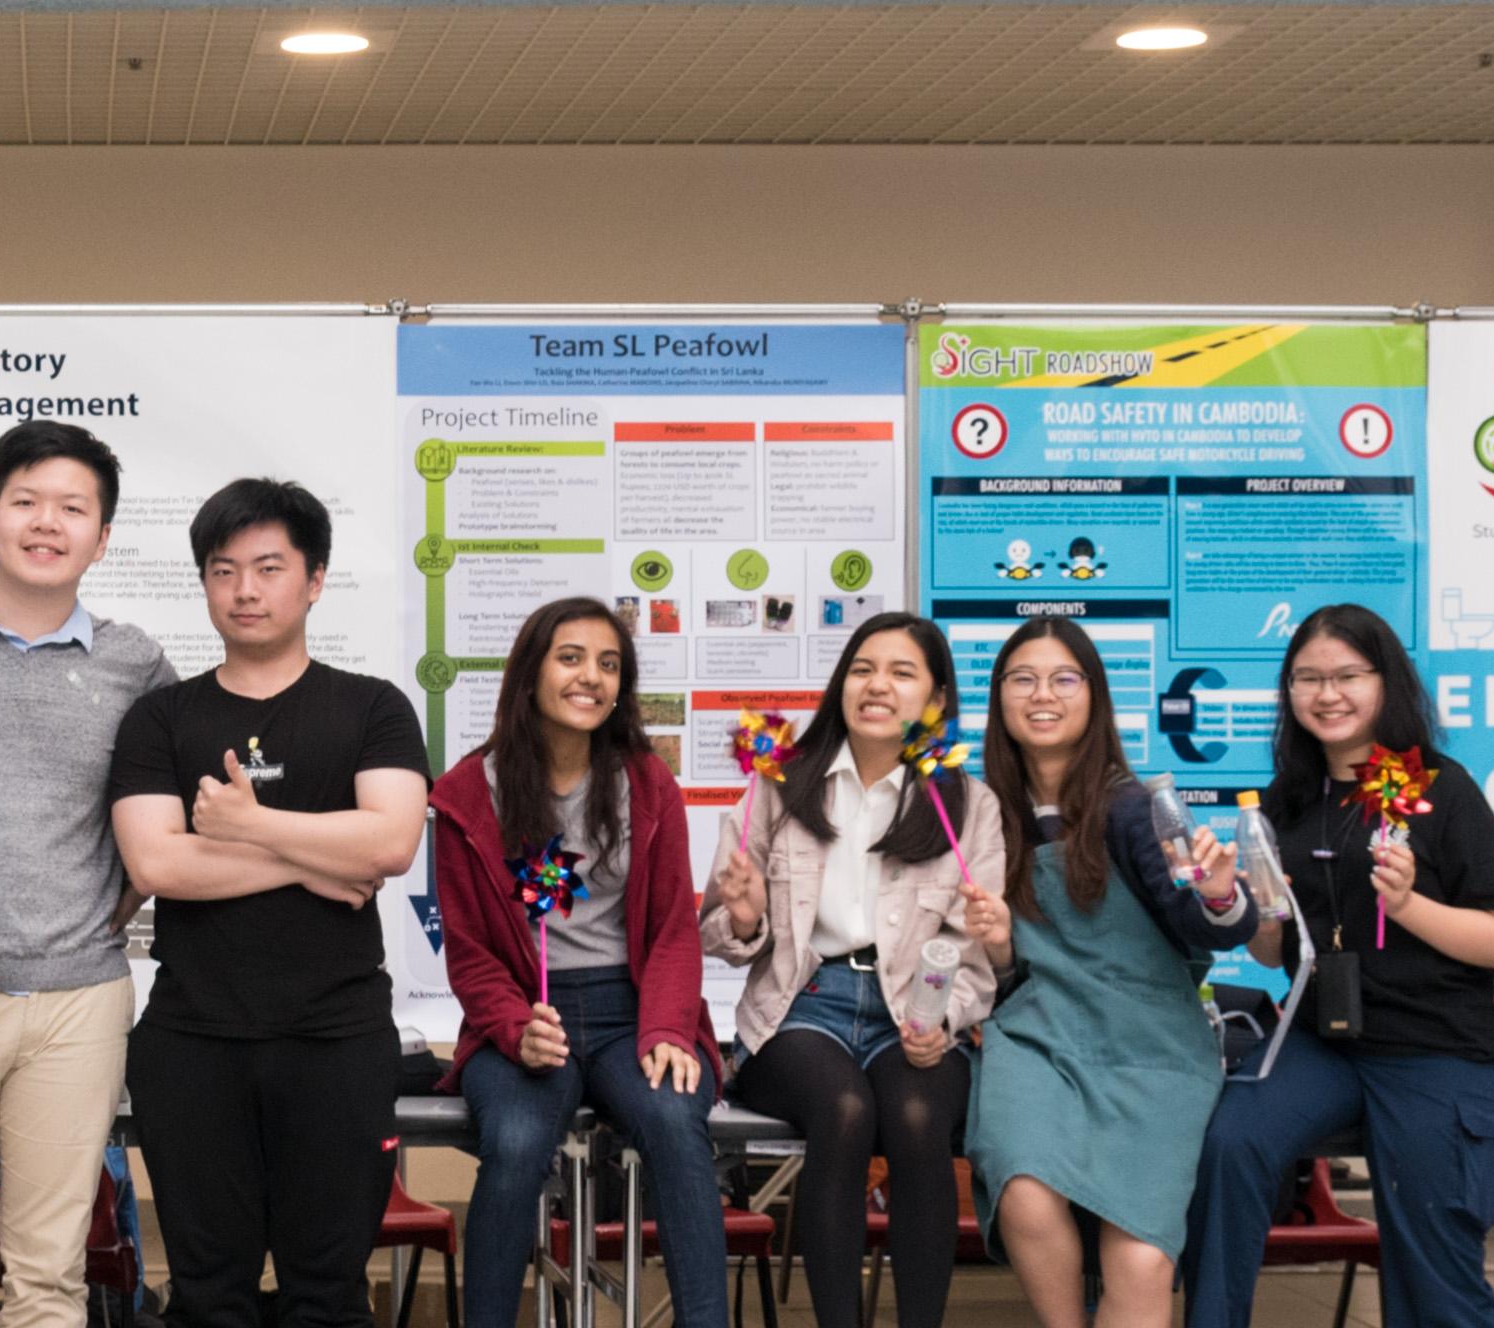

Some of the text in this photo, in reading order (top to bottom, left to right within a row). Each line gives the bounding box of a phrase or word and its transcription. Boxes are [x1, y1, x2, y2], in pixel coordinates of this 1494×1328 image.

[530, 333, 769, 357] Team SL Peafowl
[932, 333, 1153, 377] SIGHT ROADSHOW
[534, 368, 573, 376] Tackling
[575, 368, 590, 376] the
[671, 368, 707, 376] Conflict
[709, 368, 718, 376] in
[735, 368, 765, 376] Lanka
[421, 408, 598, 431] Project Timeline
[1043, 403, 1305, 423] ROAD SAFETY IN CAMBODIA:
[665, 425, 705, 433] Problem
[1047, 429, 1099, 443] WORKING
[1237, 429, 1250, 443] TO
[1253, 429, 1302, 443] DEVELOP
[457, 445, 504, 453] Literature
[1076, 448, 1089, 462] TO
[1160, 448, 1185, 462] SAFE
[980, 479, 1122, 492] BACKGROUND INFORMATION
[1246, 478, 1345, 492] PROJECT OVERVIEW
[107, 547, 139, 557] stem
[472, 542, 540, 550] Internal Check
[1016, 602, 1087, 616] COMPONENTS
[408, 990, 454, 1000] Acknowle
